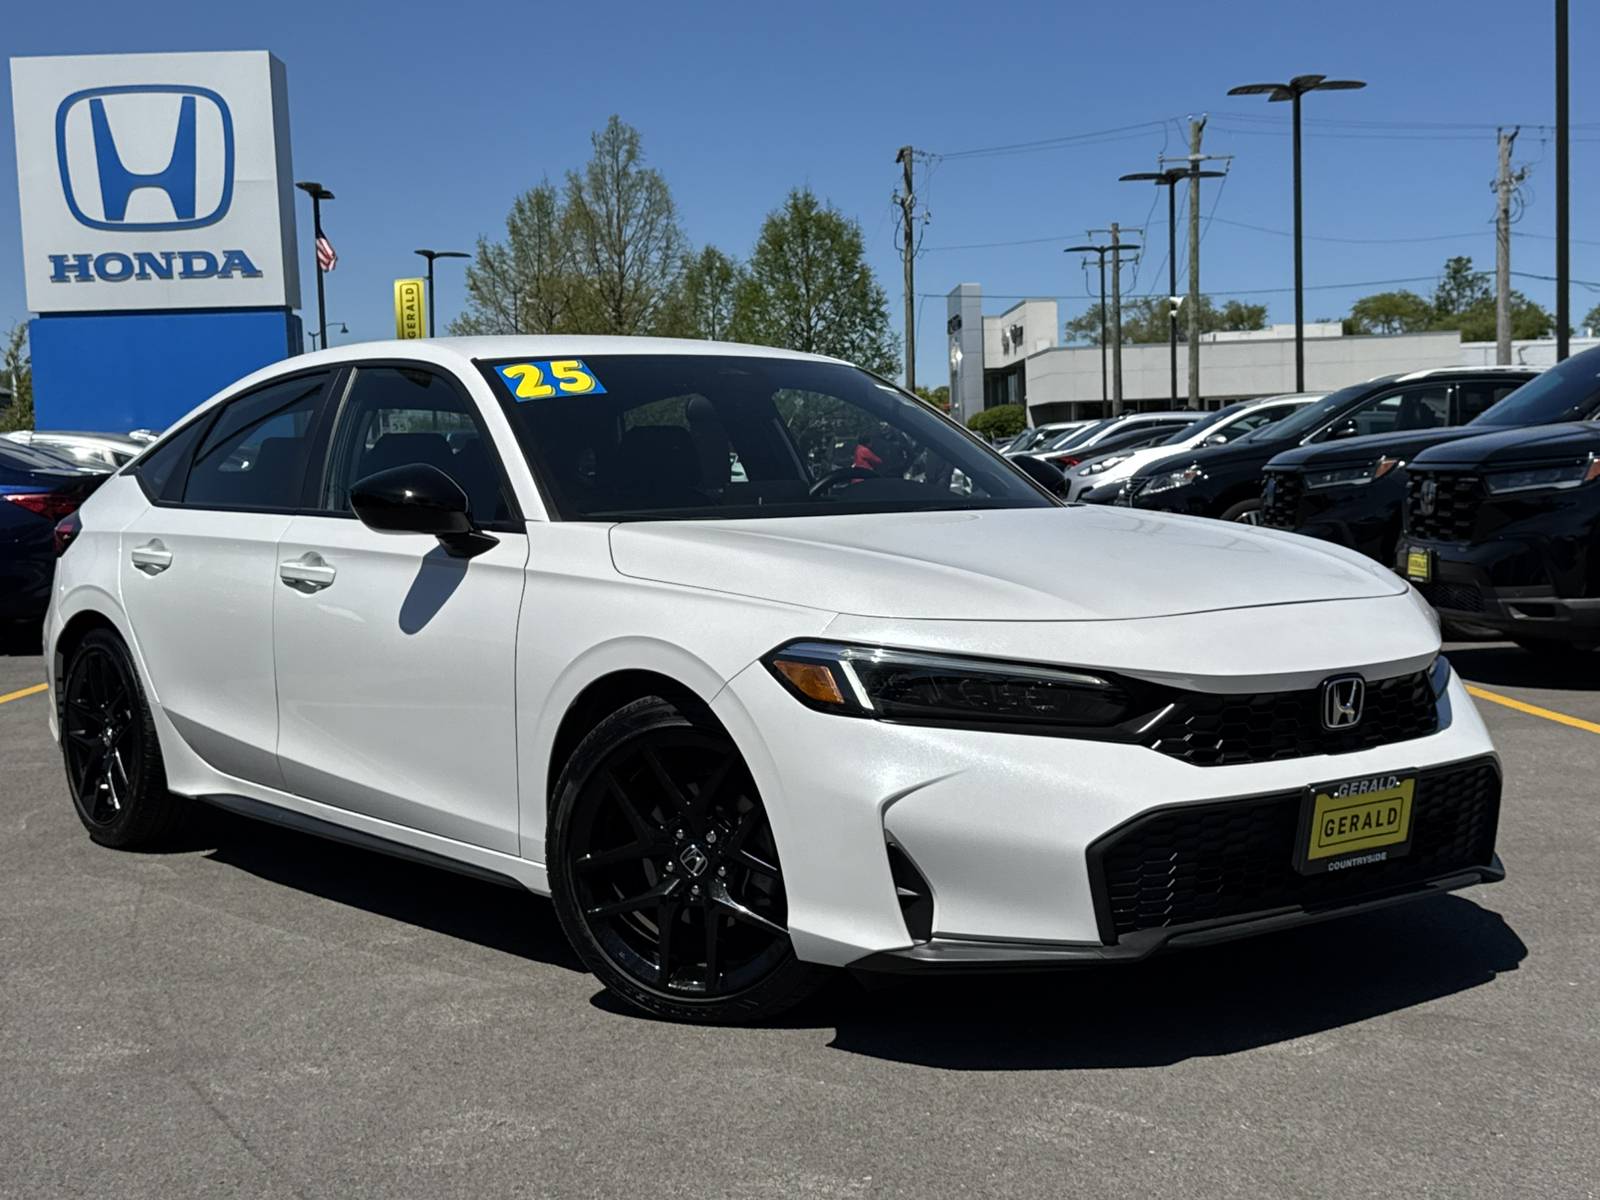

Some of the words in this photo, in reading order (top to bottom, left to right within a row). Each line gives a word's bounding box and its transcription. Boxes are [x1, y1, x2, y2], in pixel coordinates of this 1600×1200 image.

[48, 250, 263, 283] HONDA
[405, 288, 417, 339] GERALD
[502, 361, 596, 398] 25
[1338, 775, 1397, 798] GERALD
[1324, 807, 1398, 838] GERALD
[1328, 852, 1387, 872] COUNTRYSIDE
